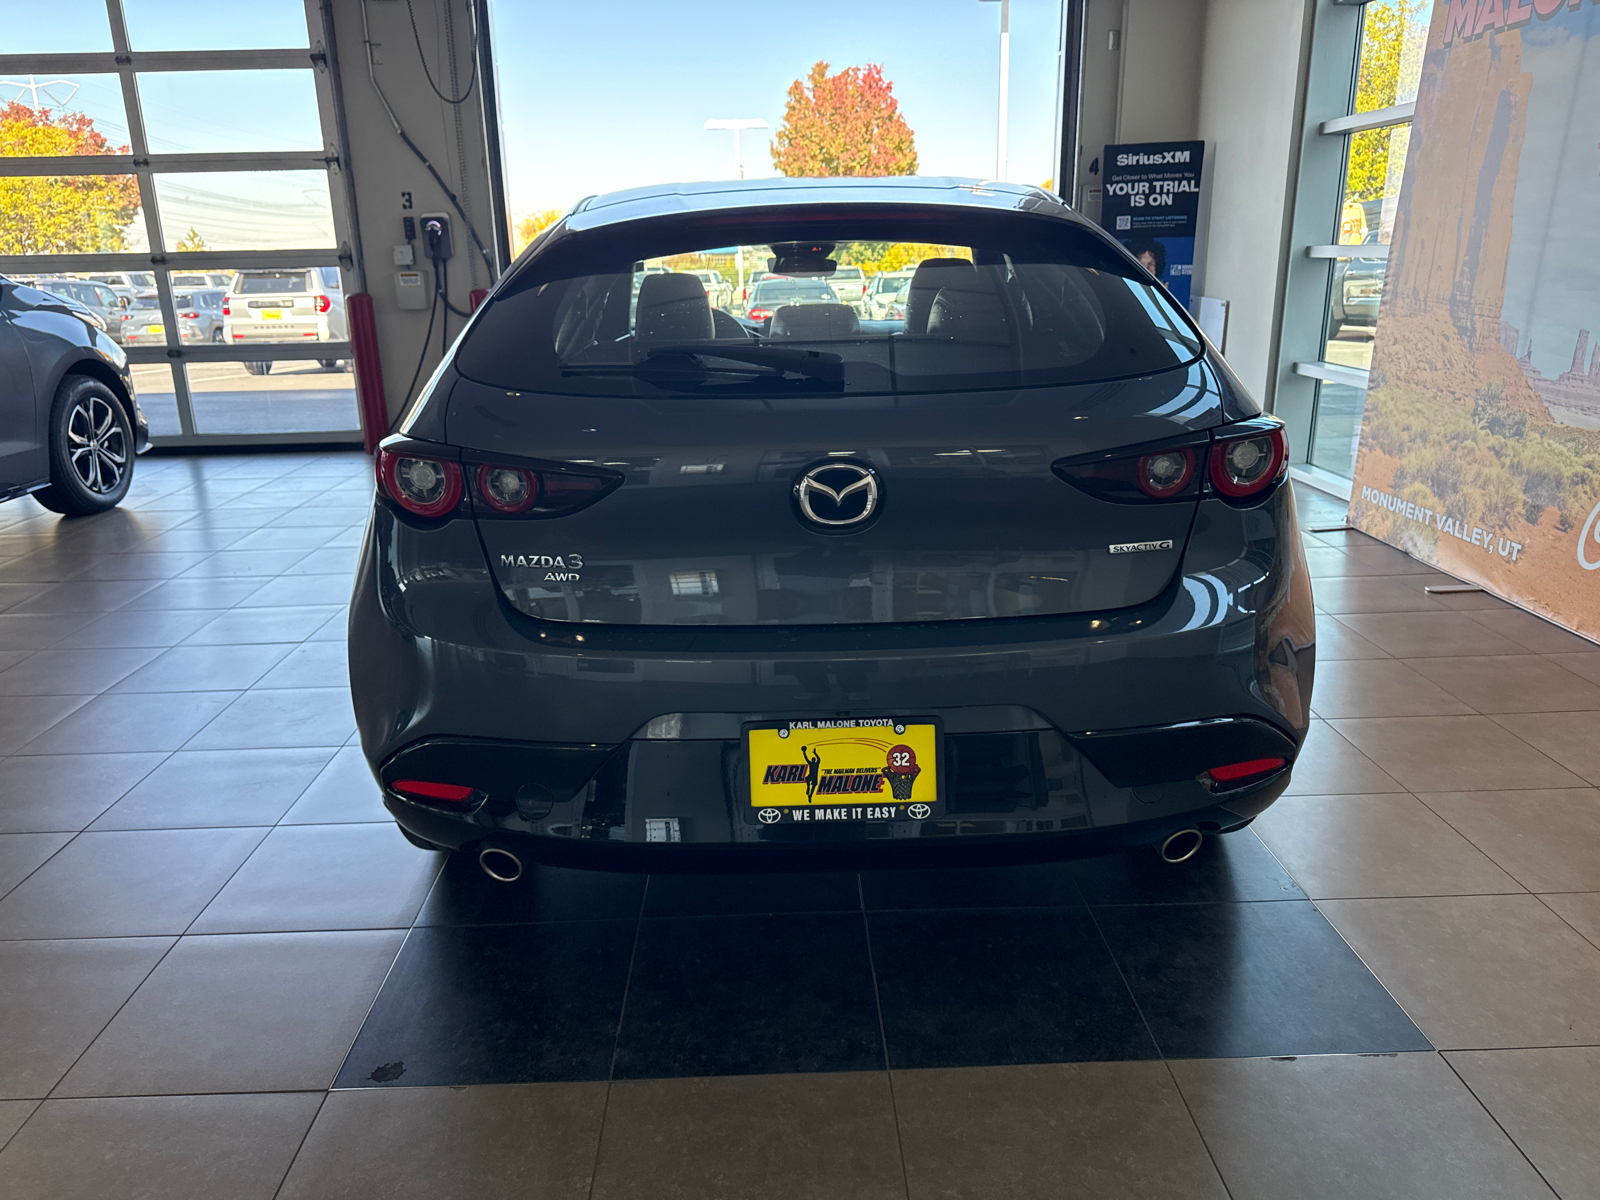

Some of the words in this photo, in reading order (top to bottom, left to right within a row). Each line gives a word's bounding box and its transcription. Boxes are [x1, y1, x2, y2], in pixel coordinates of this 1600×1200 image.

[1443, 0, 1600, 49] MAL
[1117, 151, 1190, 166] SiriusXM
[1089, 157, 1100, 176] 4
[1106, 182, 1149, 196] YOUR
[1153, 180, 1199, 193] TRIAL
[401, 192, 413, 210] 3
[1130, 195, 1146, 207] IS
[1149, 194, 1173, 206] ON
[1361, 485, 1433, 526] MONUMENT
[1436, 512, 1494, 555] VALLEY,
[1498, 537, 1522, 561] UT
[543, 572, 581, 582] AWD
[789, 721, 815, 730] KARL
[817, 719, 856, 729] MALONE
[859, 718, 893, 728] TOYOTA
[892, 752, 910, 767] 32
[762, 764, 809, 785] KARL
[833, 767, 855, 775] MAILMAN
[816, 773, 886, 795] MALONE
[792, 809, 810, 821] WE
[815, 808, 847, 820] MAKE
[852, 807, 863, 819] IT
[867, 806, 896, 819] EASY
